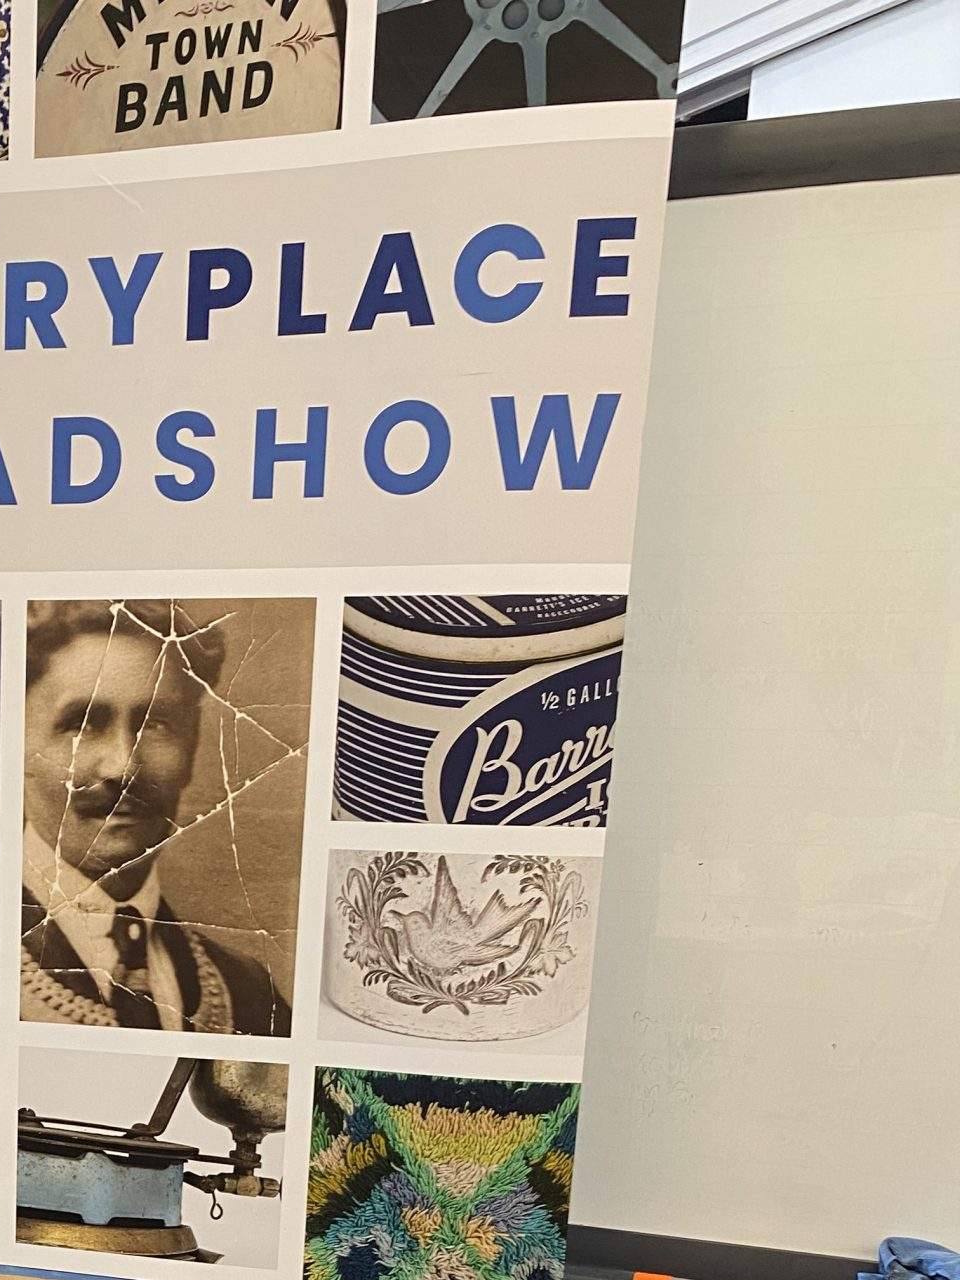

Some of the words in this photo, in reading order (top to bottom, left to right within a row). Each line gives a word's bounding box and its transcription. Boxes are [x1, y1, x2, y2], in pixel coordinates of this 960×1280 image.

[145, 19, 263, 71] TOWN
[115, 60, 274, 133] BAND
[566, 678, 619, 707] GALL
[451, 718, 616, 824] Barr
